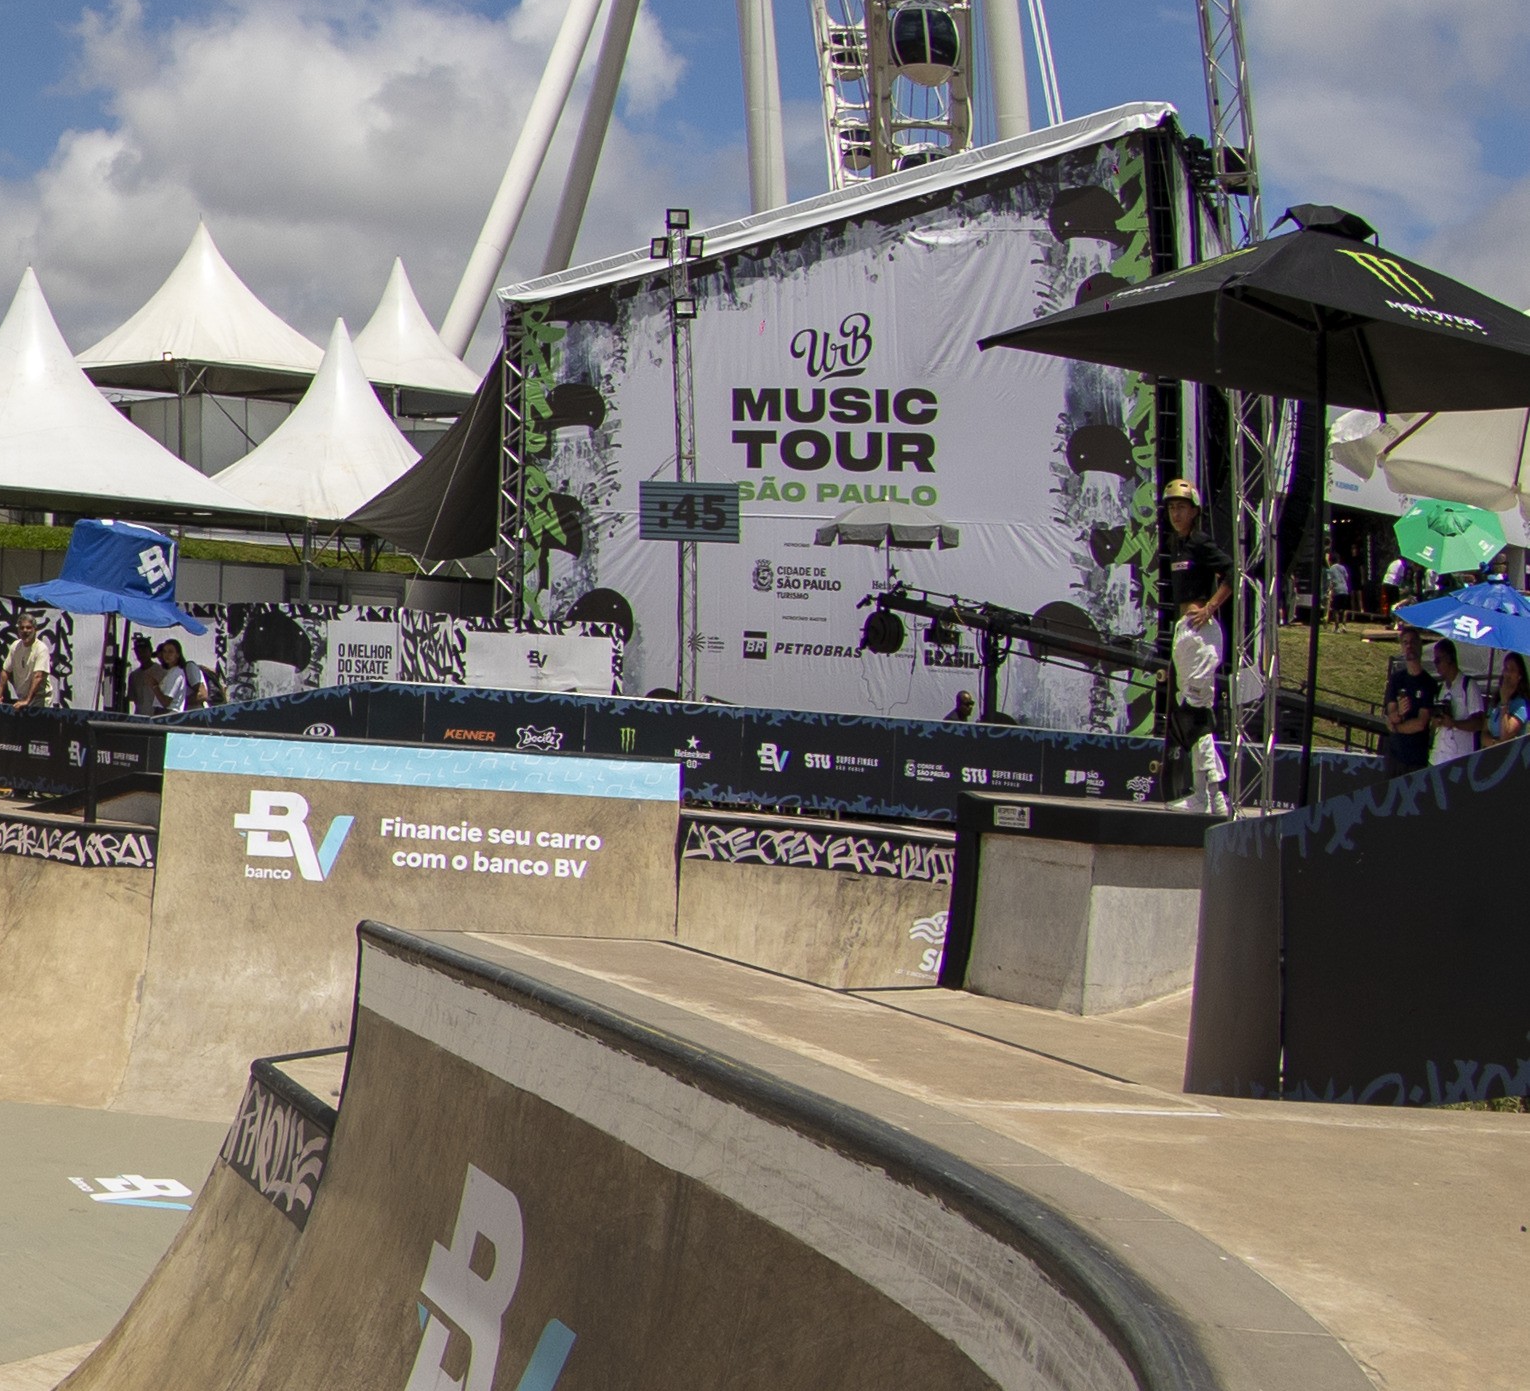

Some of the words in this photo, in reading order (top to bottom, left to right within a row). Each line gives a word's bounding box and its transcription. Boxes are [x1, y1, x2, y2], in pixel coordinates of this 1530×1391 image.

[732, 387, 938, 425] MUSIC
[732, 428, 936, 473] TOUR
[739, 475, 805, 503] SÃO
[816, 482, 937, 506] PAULO
[777, 566, 810, 576] CIDADE
[813, 567, 826, 577] DE
[777, 576, 800, 589] SÃO
[803, 579, 841, 591] PAULO
[777, 592, 809, 600] TURISMO
[338, 643, 345, 657] O
[348, 644, 392, 659] MELHOR
[746, 640, 765, 652] BR
[774, 642, 863, 659] PETROBRAS
[338, 659, 351, 673] DO
[354, 660, 388, 675] SKATE
[444, 728, 496, 742] KENNER
[804, 752, 831, 769] STU
[961, 767, 988, 784] STU
[233, 790, 356, 883] BV
[380, 817, 478, 844] Financie
[487, 825, 531, 846] seu
[536, 829, 602, 852] carro
[244, 864, 292, 881] banco
[392, 850, 447, 870] com
[451, 853, 468, 871] o
[472, 850, 549, 877] banco
[554, 859, 588, 880] BV
